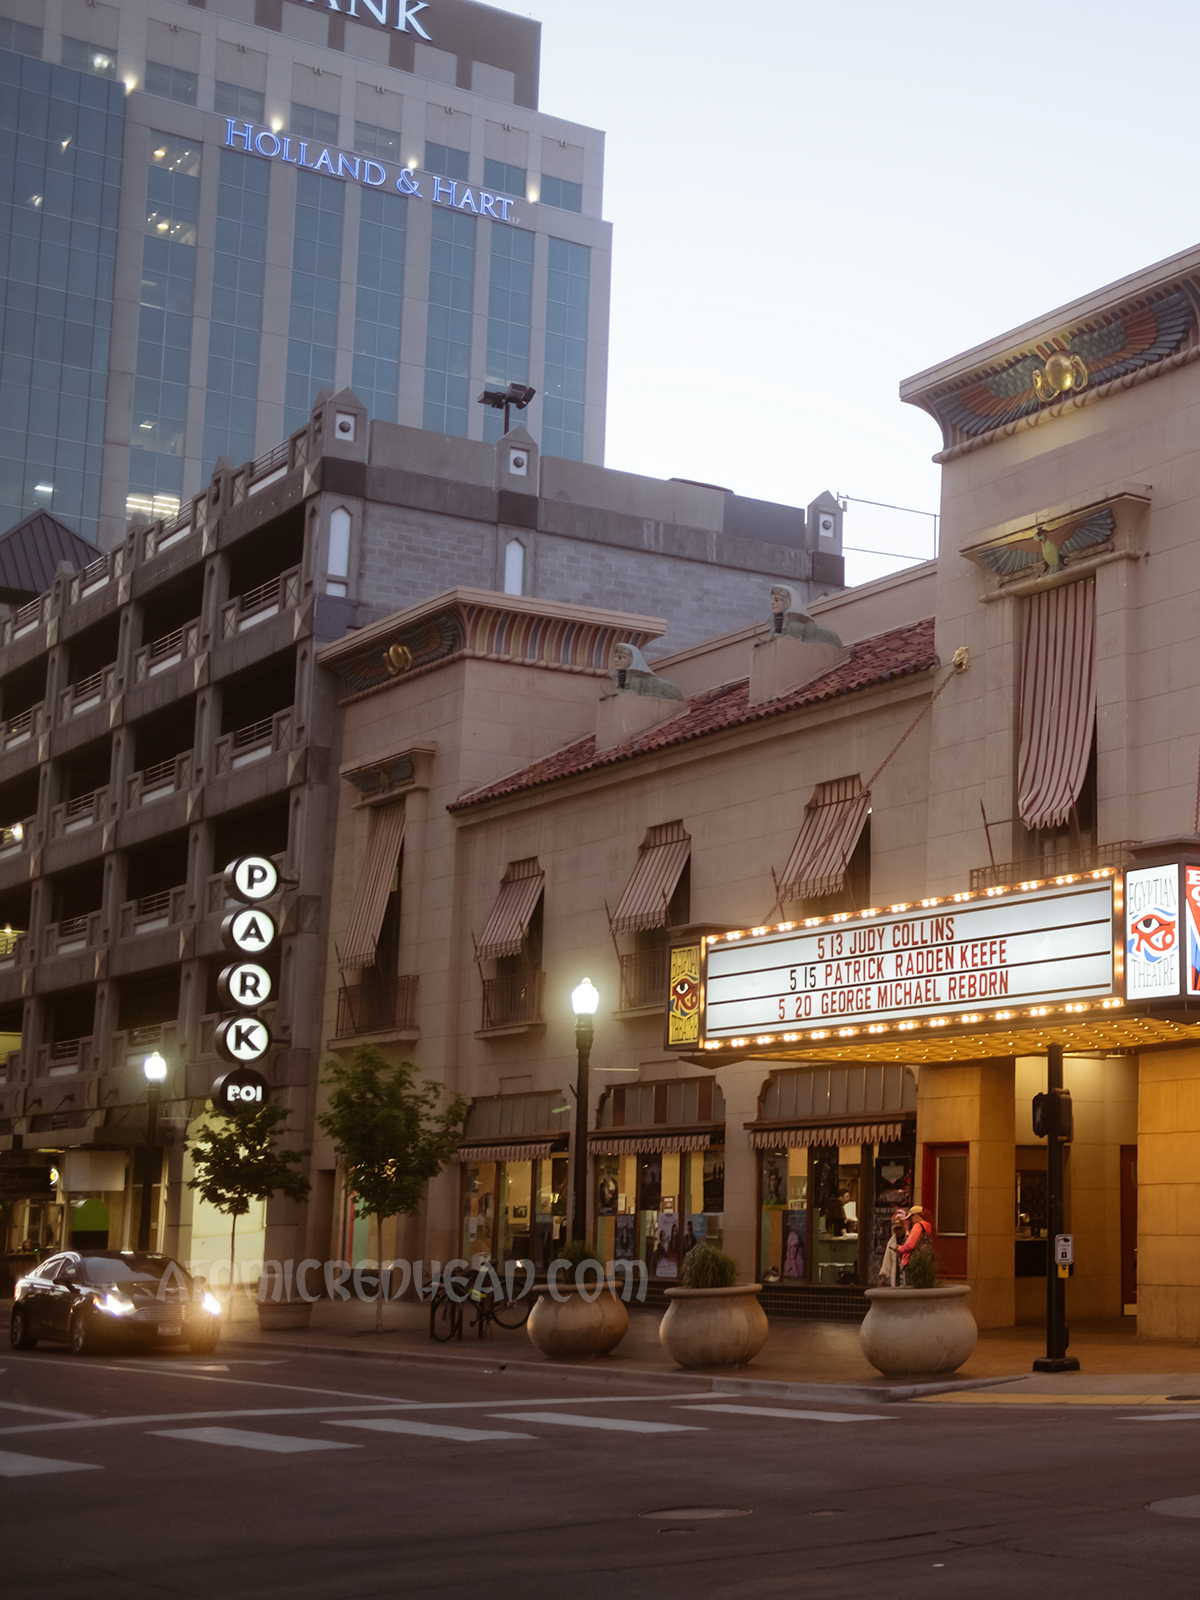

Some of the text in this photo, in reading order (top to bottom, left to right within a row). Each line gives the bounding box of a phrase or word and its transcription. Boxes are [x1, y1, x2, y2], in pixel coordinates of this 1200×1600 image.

[304, 0, 433, 41] NK
[225, 119, 386, 187] HOLLAND
[396, 167, 423, 198] &
[432, 176, 514, 222] HART
[1129, 876, 1177, 915] EGYPTIAN
[234, 864, 267, 1051] PARK
[818, 917, 955, 959] 5 13 JUDY COLLINS
[790, 939, 1007, 990] 5 15 PATRICK RADDEN KEEFE
[1131, 954, 1176, 989] THEATRE
[778, 970, 1009, 1020] 5 20 GEORGE MICHAEL REBORN
